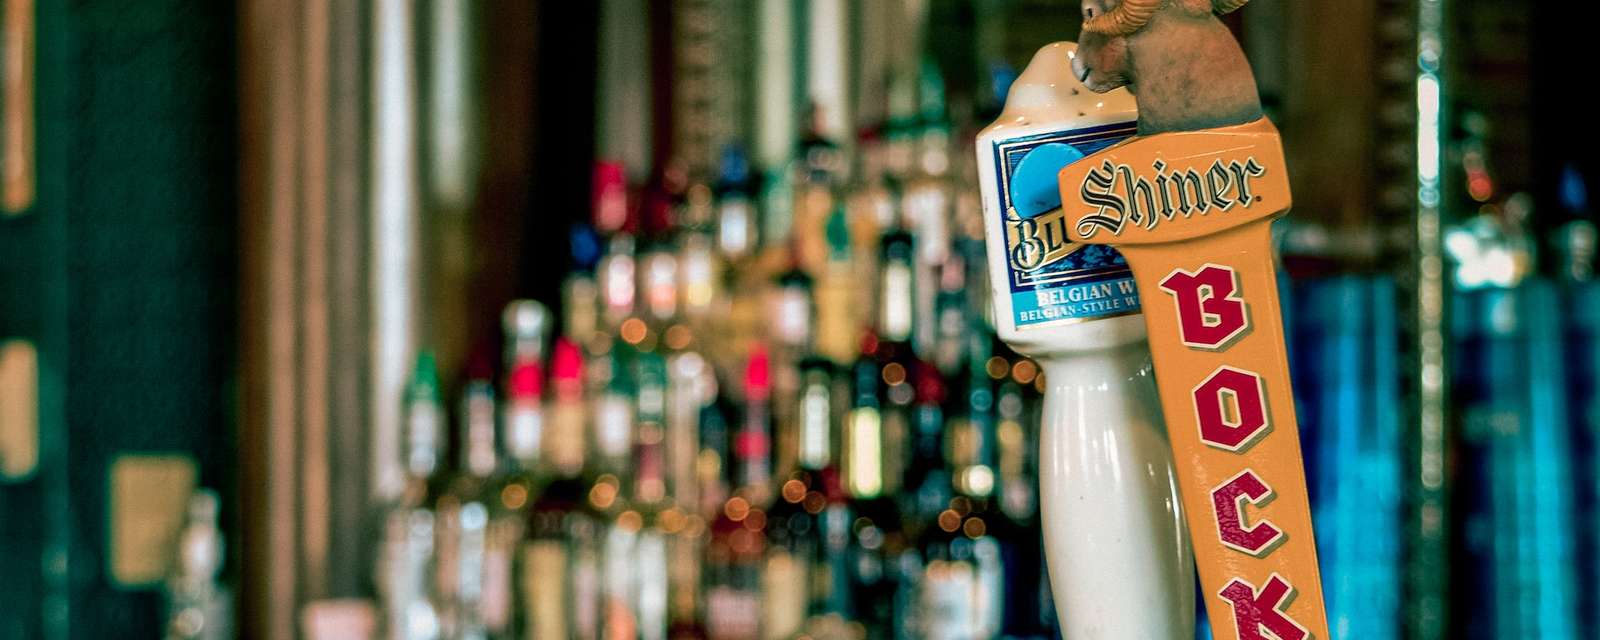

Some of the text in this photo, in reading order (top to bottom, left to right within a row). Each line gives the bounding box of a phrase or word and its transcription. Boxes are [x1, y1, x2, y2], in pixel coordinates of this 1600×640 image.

[1076, 159, 1265, 238] Shiner
[1020, 296, 1138, 322] BELGIAN-STYLE W
[1037, 280, 1135, 307] BELGIAN W
[1159, 263, 1311, 640] BOCK
